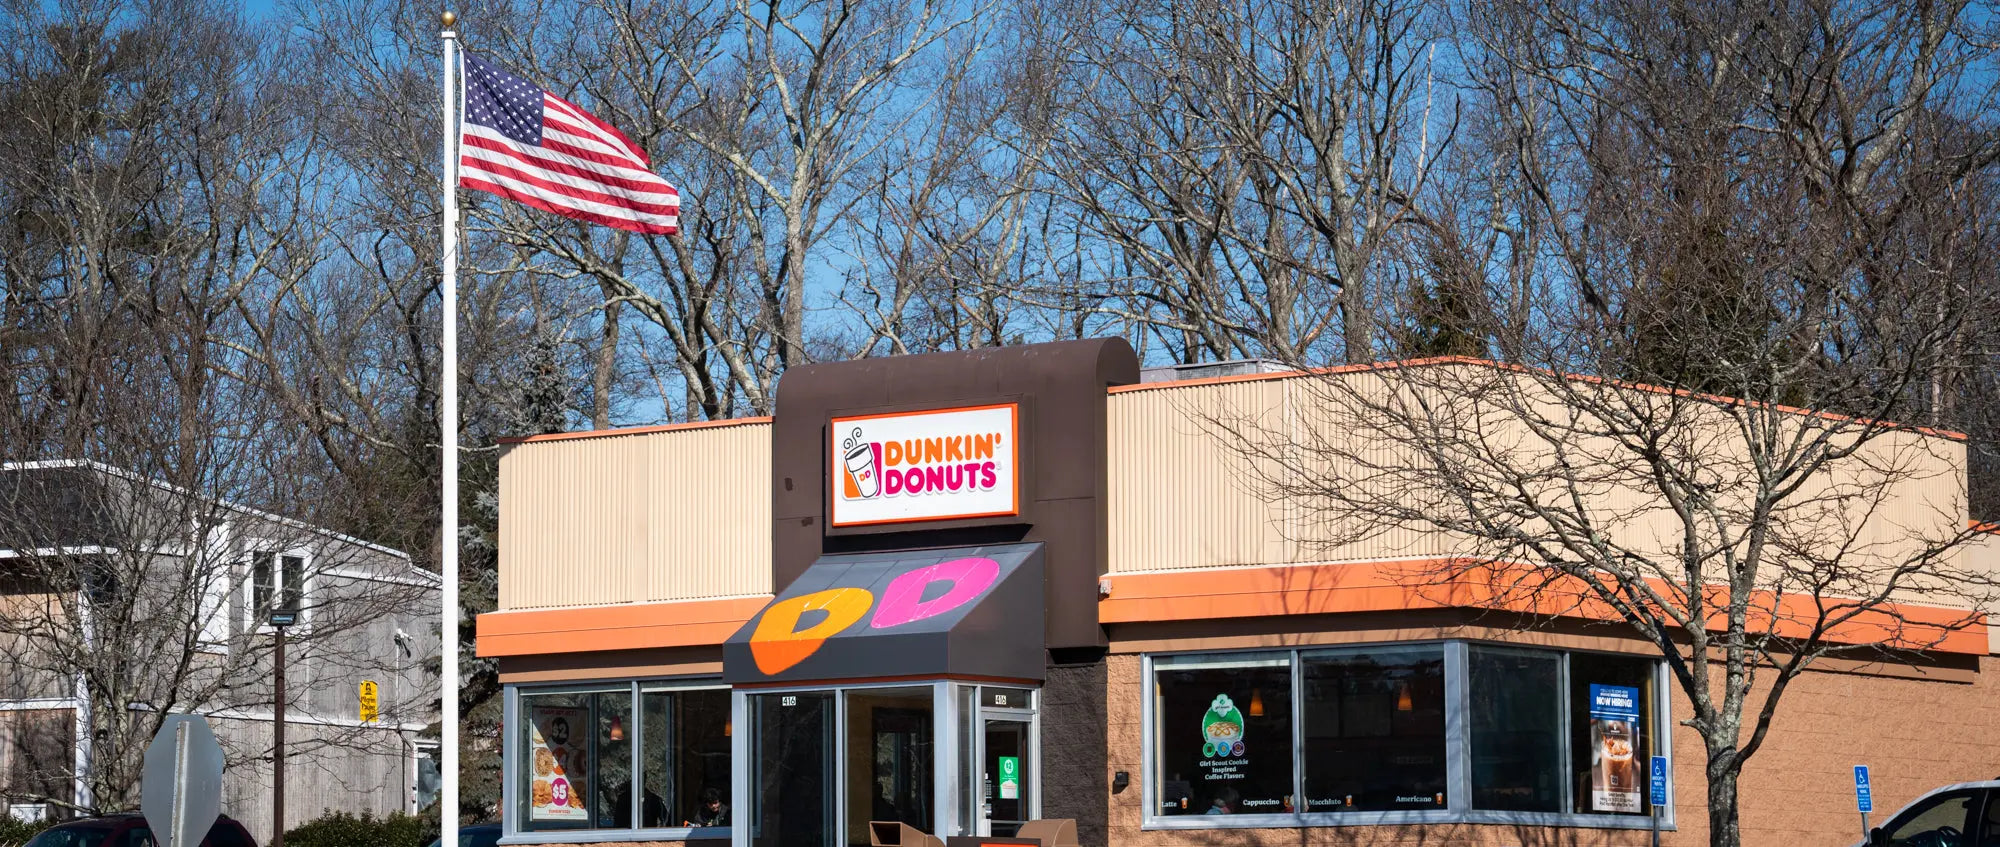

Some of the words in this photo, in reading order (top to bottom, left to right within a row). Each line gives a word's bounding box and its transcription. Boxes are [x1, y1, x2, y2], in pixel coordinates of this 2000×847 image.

[885, 432, 1002, 466] DUNKIN'
[885, 462, 997, 495] DONUTS
[783, 696, 796, 705] 416
[995, 695, 1006, 704] 416
[1596, 696, 1611, 706] NOW
[1611, 697, 1633, 708] HIRING!
[552, 784, 567, 800] $5
[1243, 799, 1280, 807] Cappuccino
[1395, 795, 1432, 803] Americano
